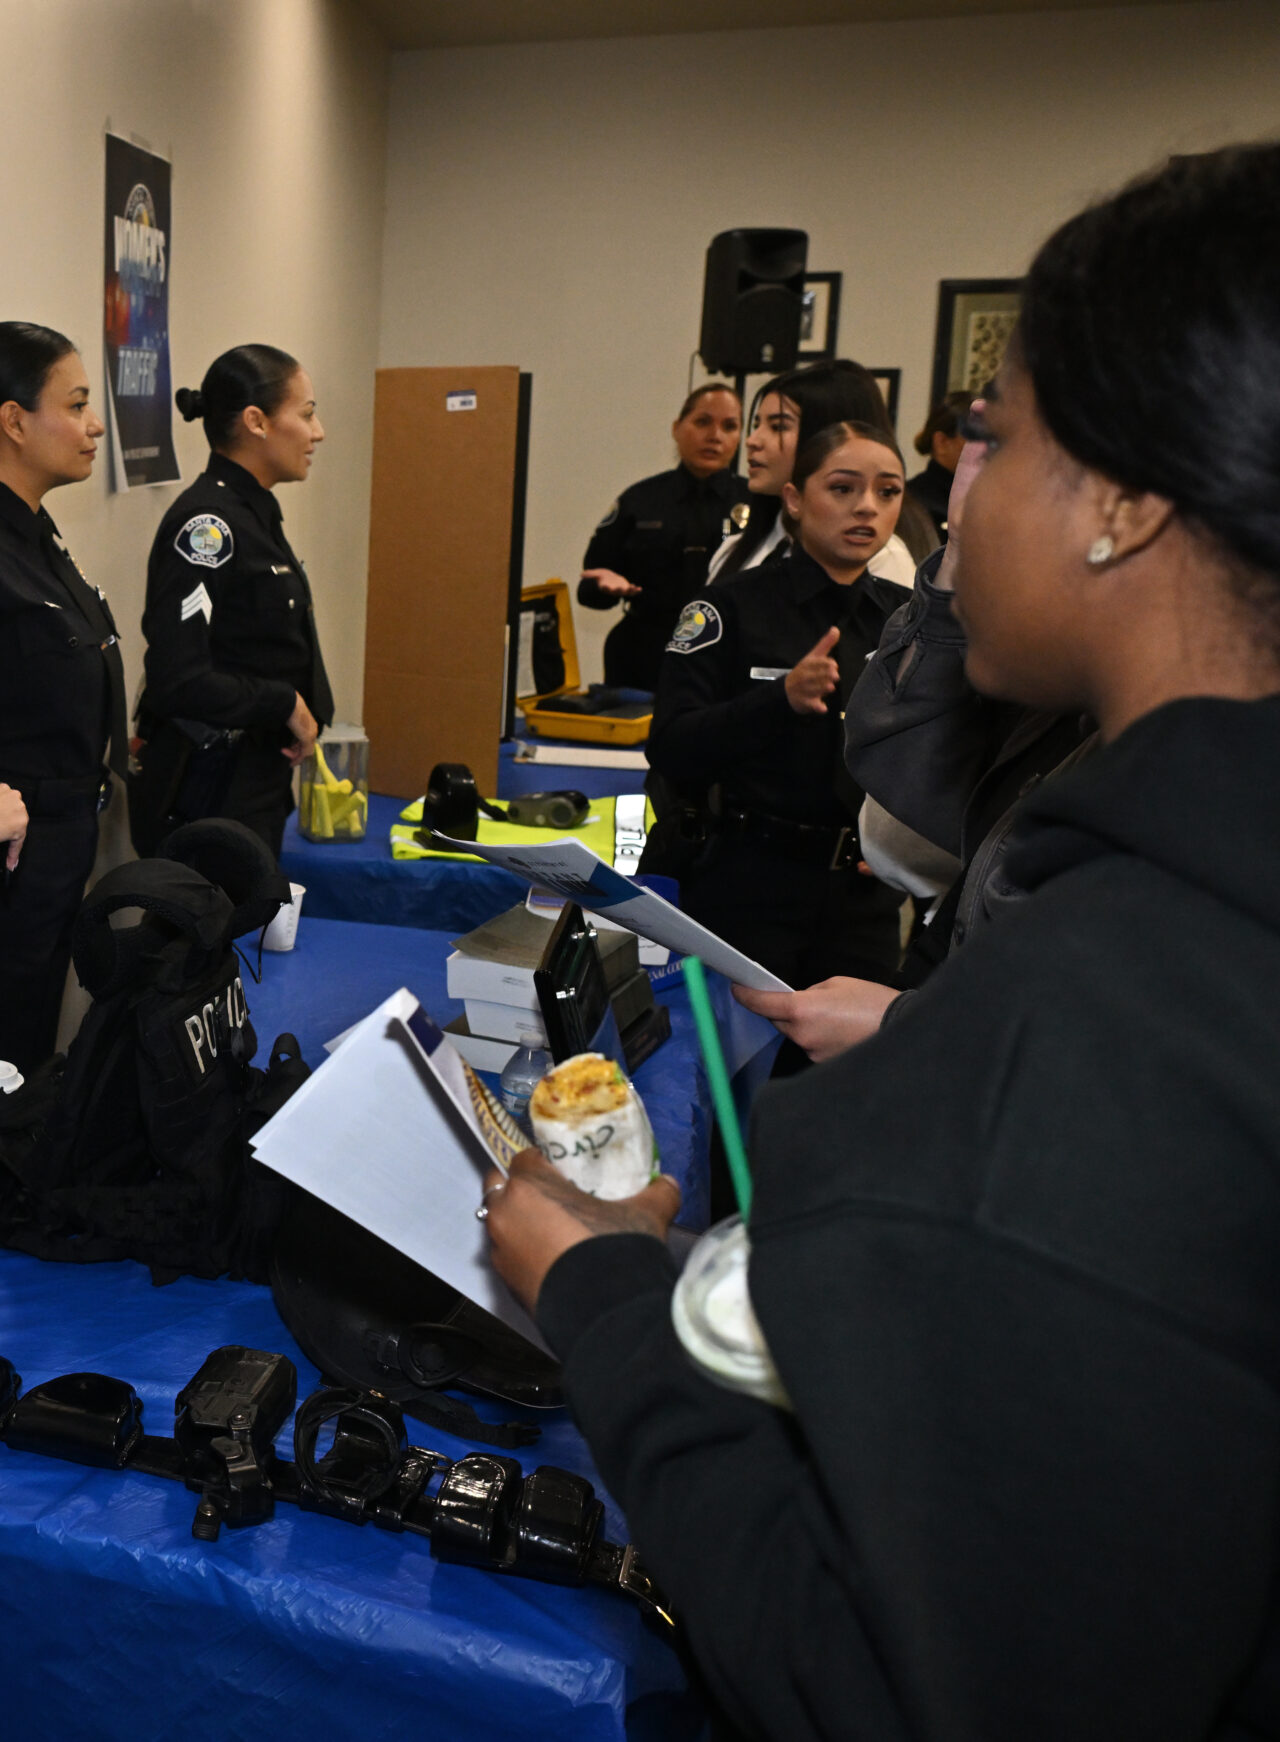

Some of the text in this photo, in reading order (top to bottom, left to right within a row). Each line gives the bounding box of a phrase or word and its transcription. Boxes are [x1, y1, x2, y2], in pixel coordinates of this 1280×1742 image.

[185, 517, 230, 537] SANTA ANA
[191, 552, 218, 566] POLICE
